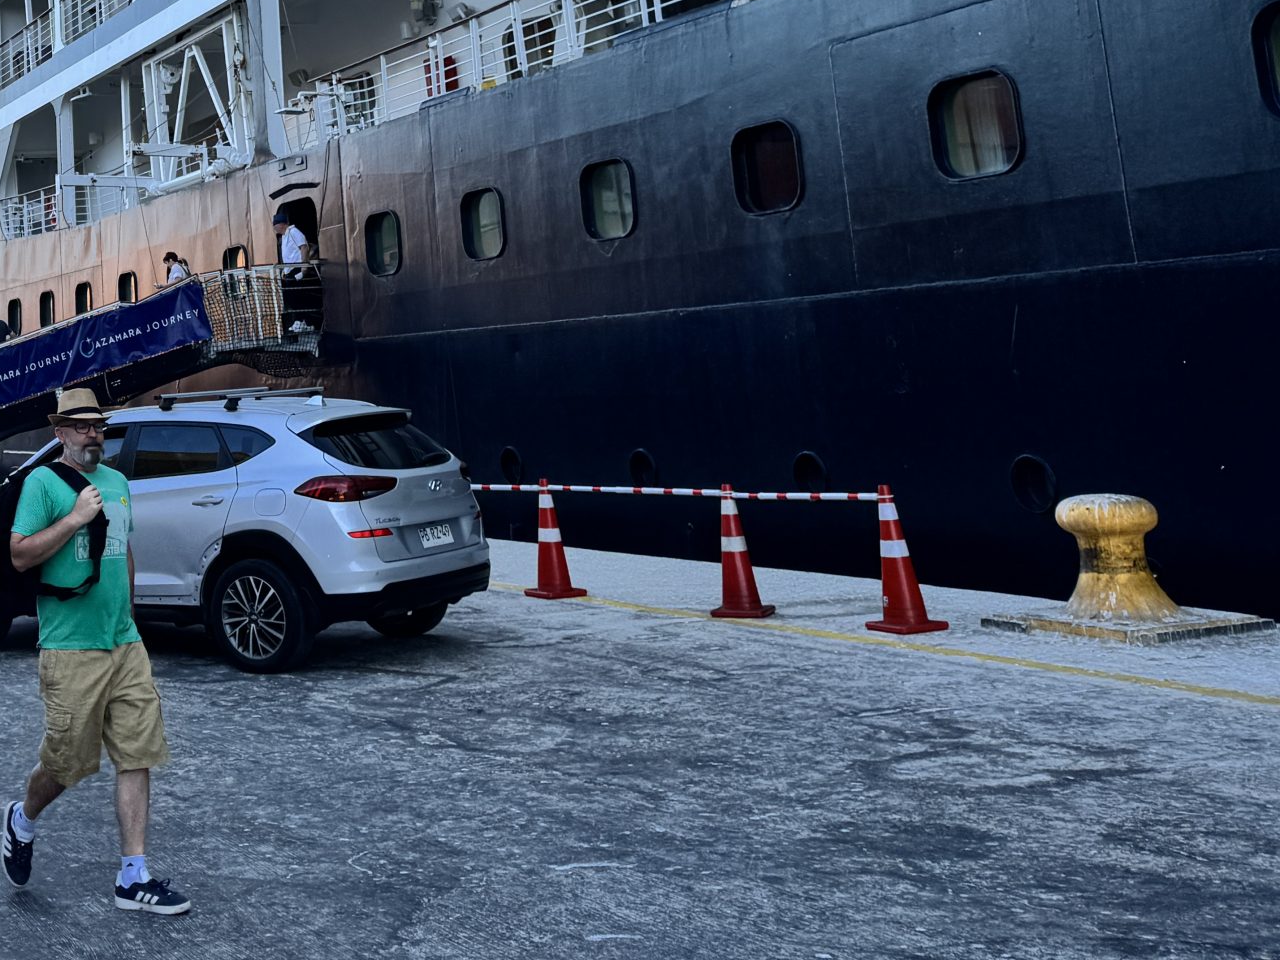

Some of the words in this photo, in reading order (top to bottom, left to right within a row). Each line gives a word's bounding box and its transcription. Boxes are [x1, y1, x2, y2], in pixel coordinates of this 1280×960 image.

[24, 350, 74, 374] JOURNEY
[95, 327, 142, 349] AZAMARA
[146, 308, 199, 333] JOURNEY
